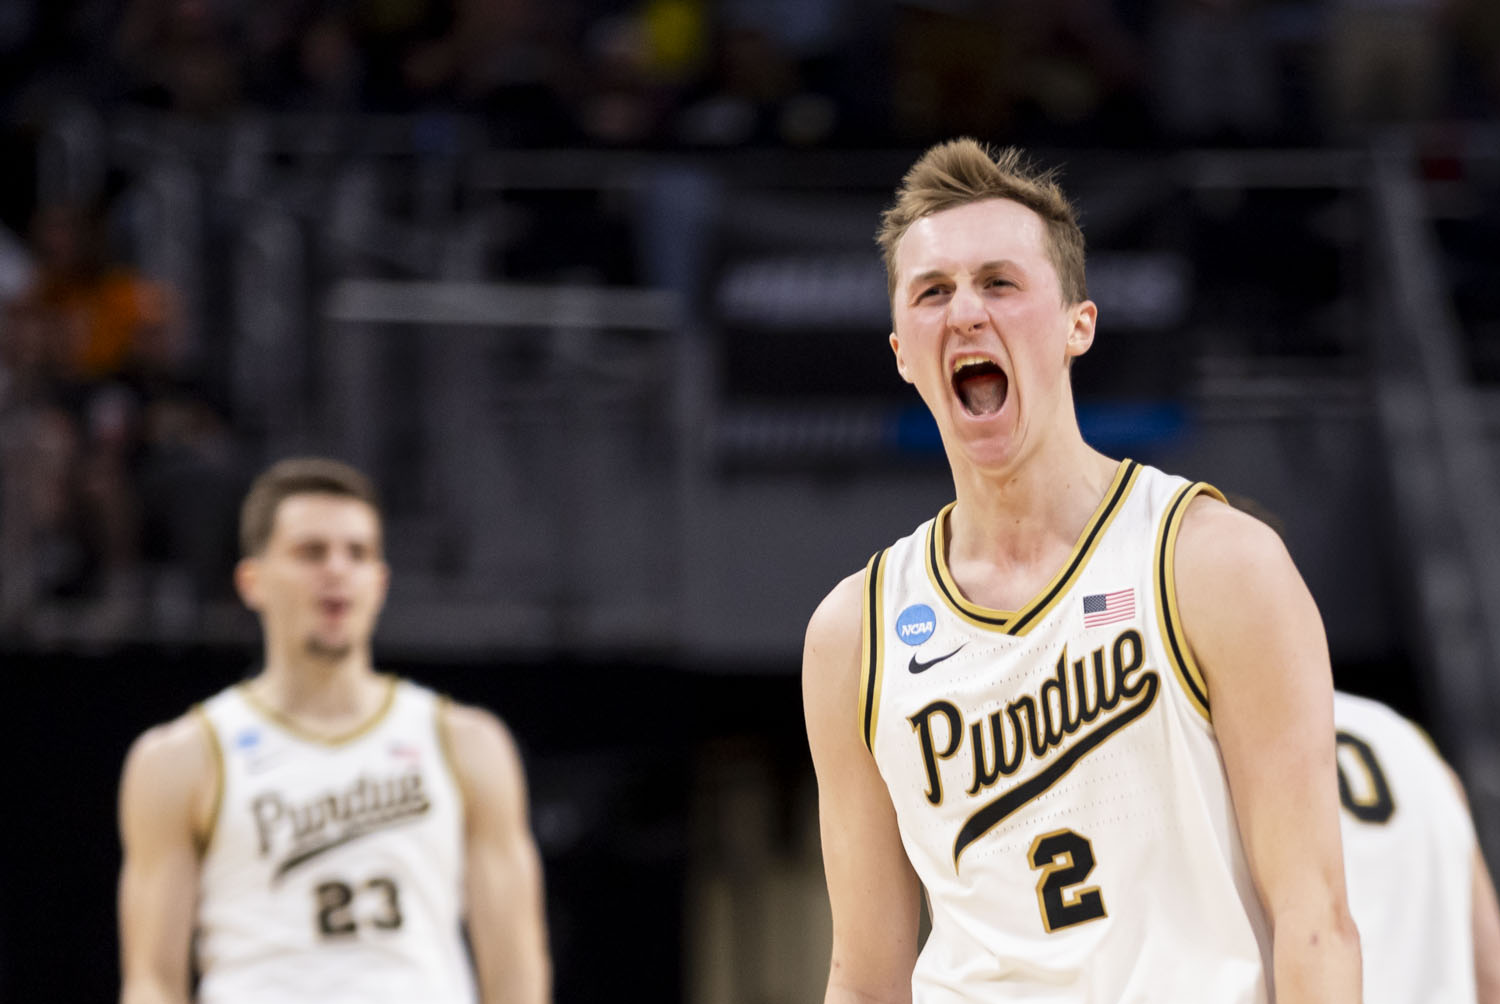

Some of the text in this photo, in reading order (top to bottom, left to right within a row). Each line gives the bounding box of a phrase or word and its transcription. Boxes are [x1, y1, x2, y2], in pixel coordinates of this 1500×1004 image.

[901, 621, 933, 637] NCAA
[905, 628, 1161, 876] Purdue
[1335, 730, 1396, 825] 0
[314, 877, 404, 938] 23
[1027, 828, 1108, 933] 2
